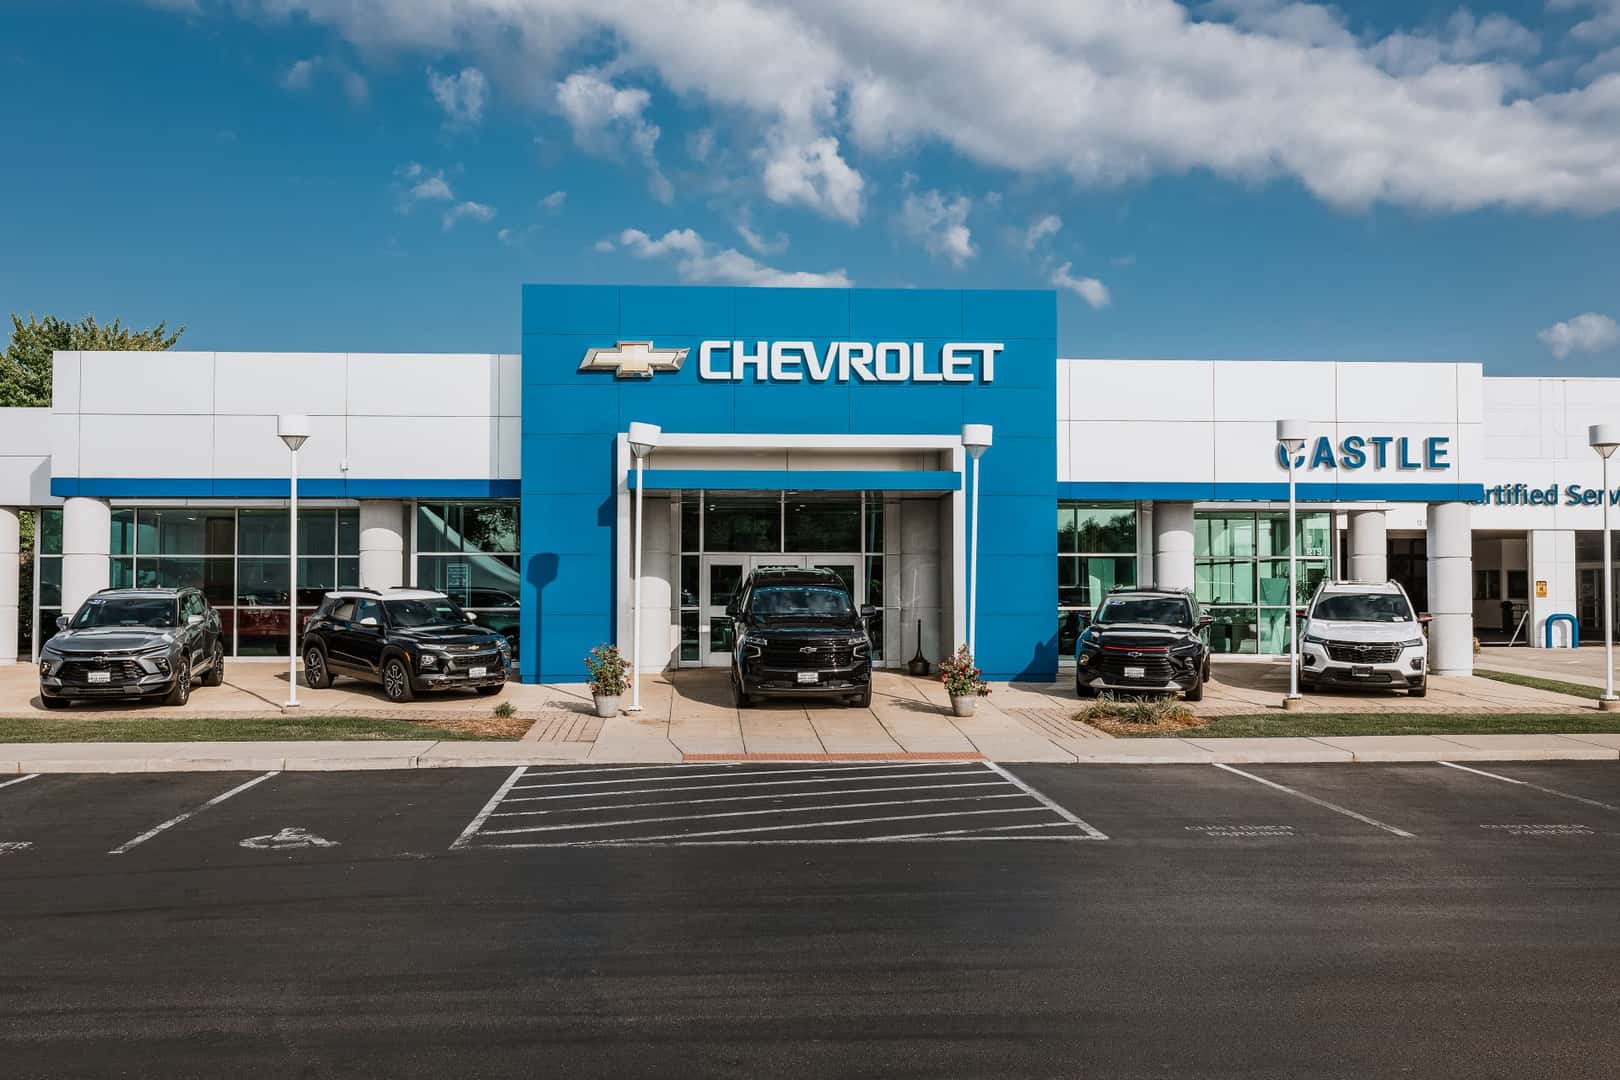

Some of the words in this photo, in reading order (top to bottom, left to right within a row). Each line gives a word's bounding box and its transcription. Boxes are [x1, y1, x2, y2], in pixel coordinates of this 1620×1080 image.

[700, 340, 1005, 382] CHEVROLET
[1278, 435, 1451, 469] CASTLE
[1472, 483, 1559, 505] rtified
